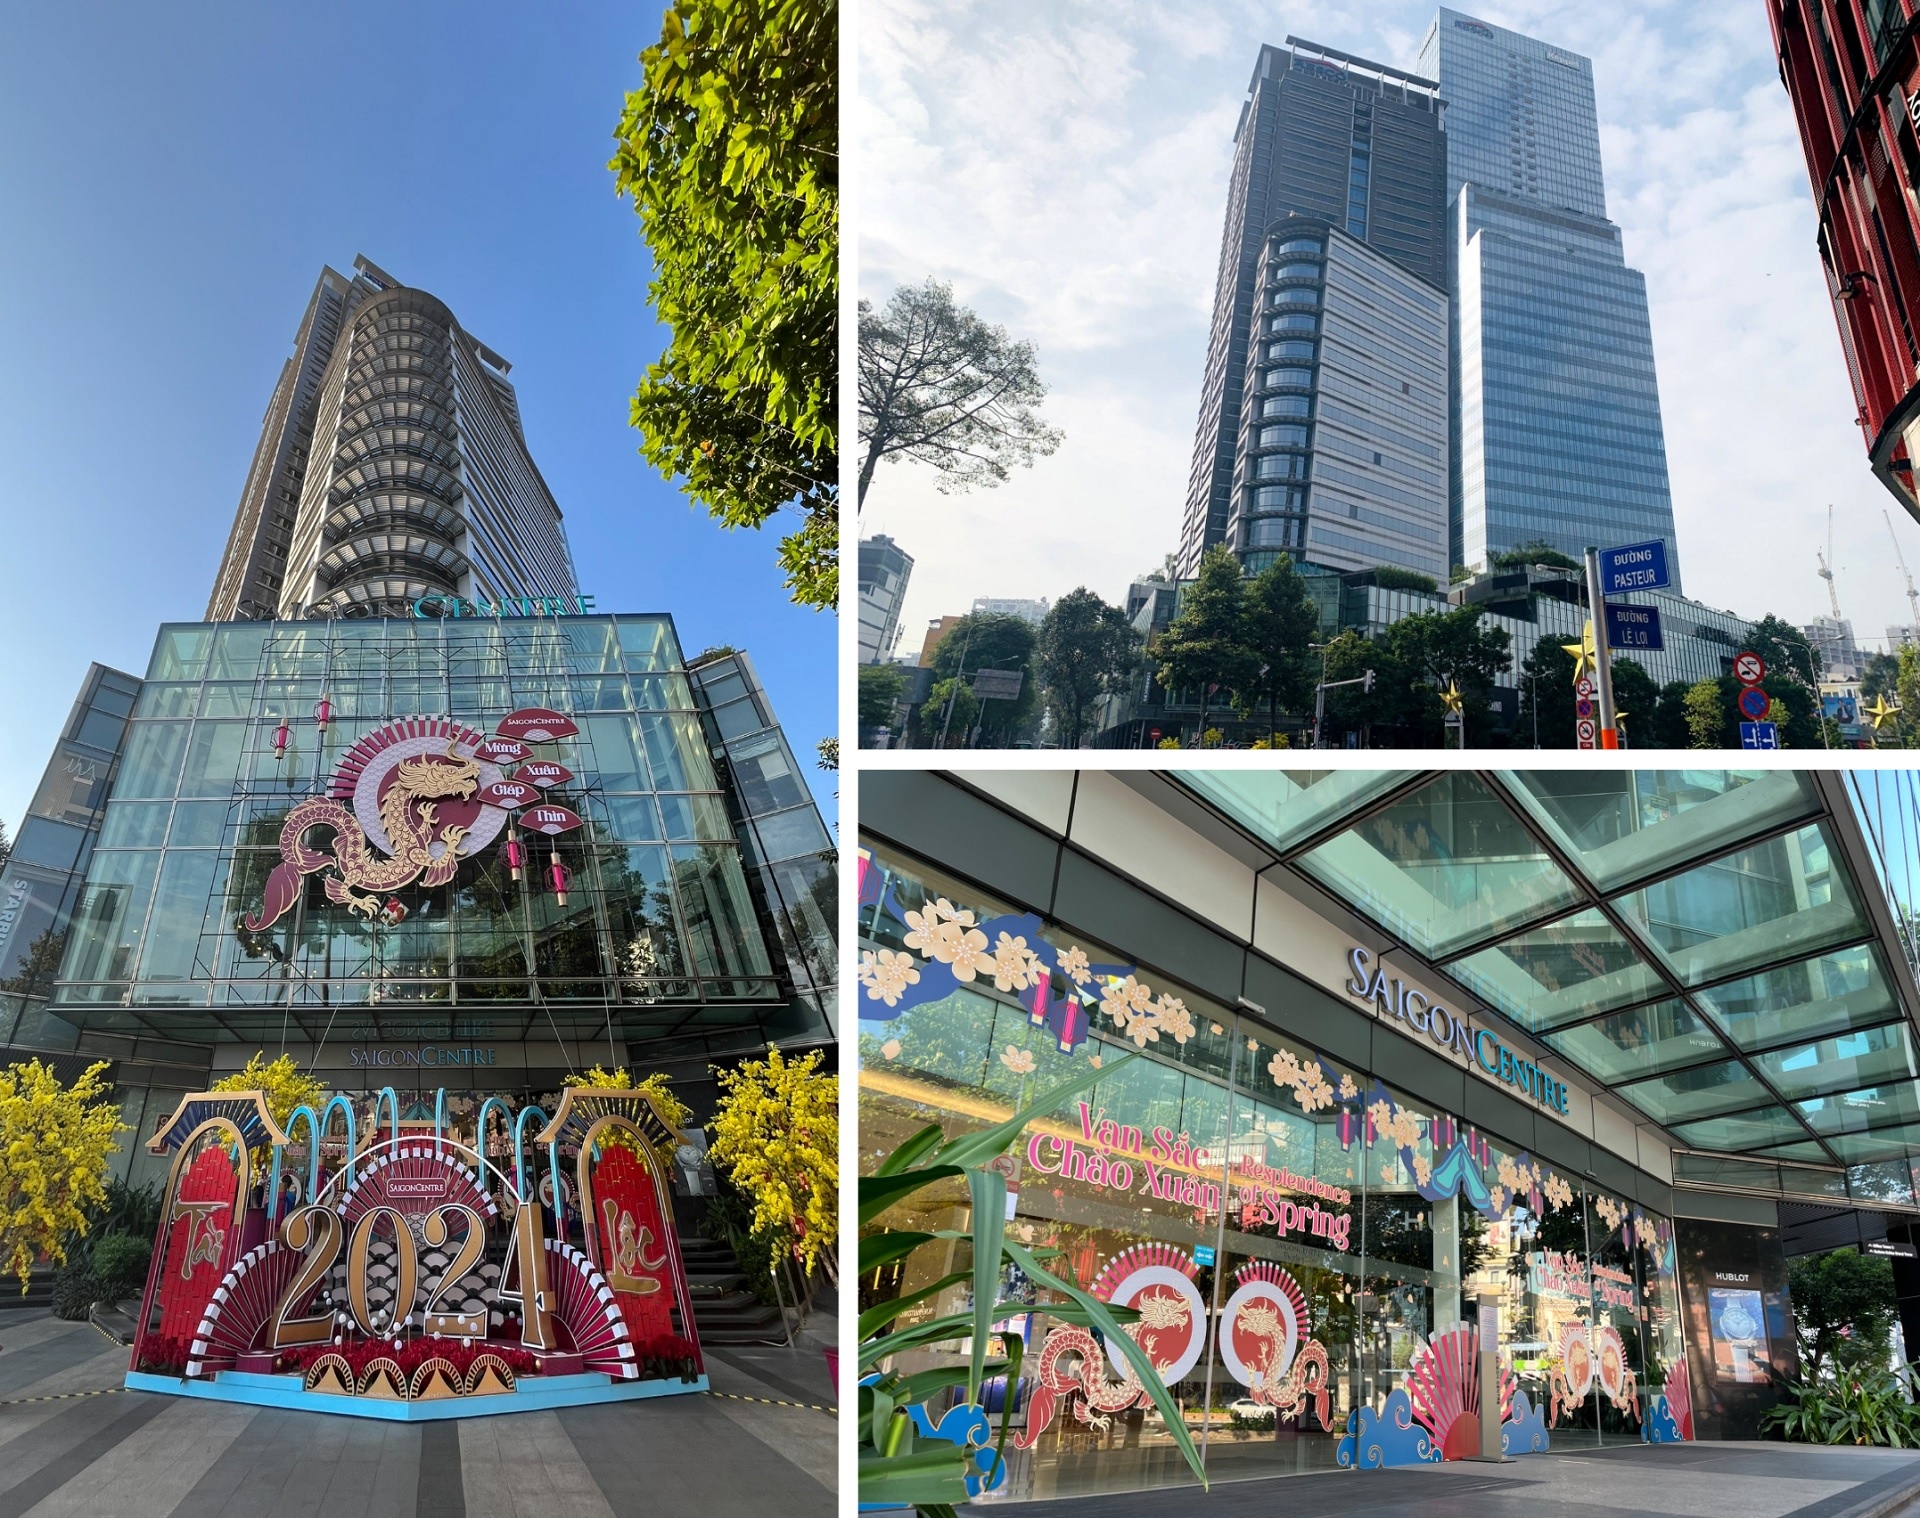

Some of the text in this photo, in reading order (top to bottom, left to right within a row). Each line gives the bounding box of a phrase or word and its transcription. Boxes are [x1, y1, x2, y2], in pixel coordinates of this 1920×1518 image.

[1614, 549, 1652, 566] ĐƯỜNG
[1614, 568, 1656, 588] PASTEUR
[1616, 610, 1649, 623] ĐƯỜNG
[1622, 627, 1633, 644] LÊ
[526, 764, 560, 776] Xuân
[492, 784, 525, 797] Giáp
[1346, 947, 1570, 1116] SAIGONCENTRE
[350, 1046, 497, 1067] SAIGONCENTRE
[1150, 1130, 1210, 1173] Sắc
[1027, 1132, 1134, 1191] Chào
[1138, 1158, 1221, 1212] Xuân
[1241, 1154, 1351, 1206] Resplendence
[389, 1182, 444, 1192] SAIGONCENTRE
[1239, 1184, 1352, 1251] of Spring
[267, 1202, 556, 1350] 2024
[1716, 1272, 1749, 1282] HUBLOT
[1601, 1279, 1634, 1313] Spring
